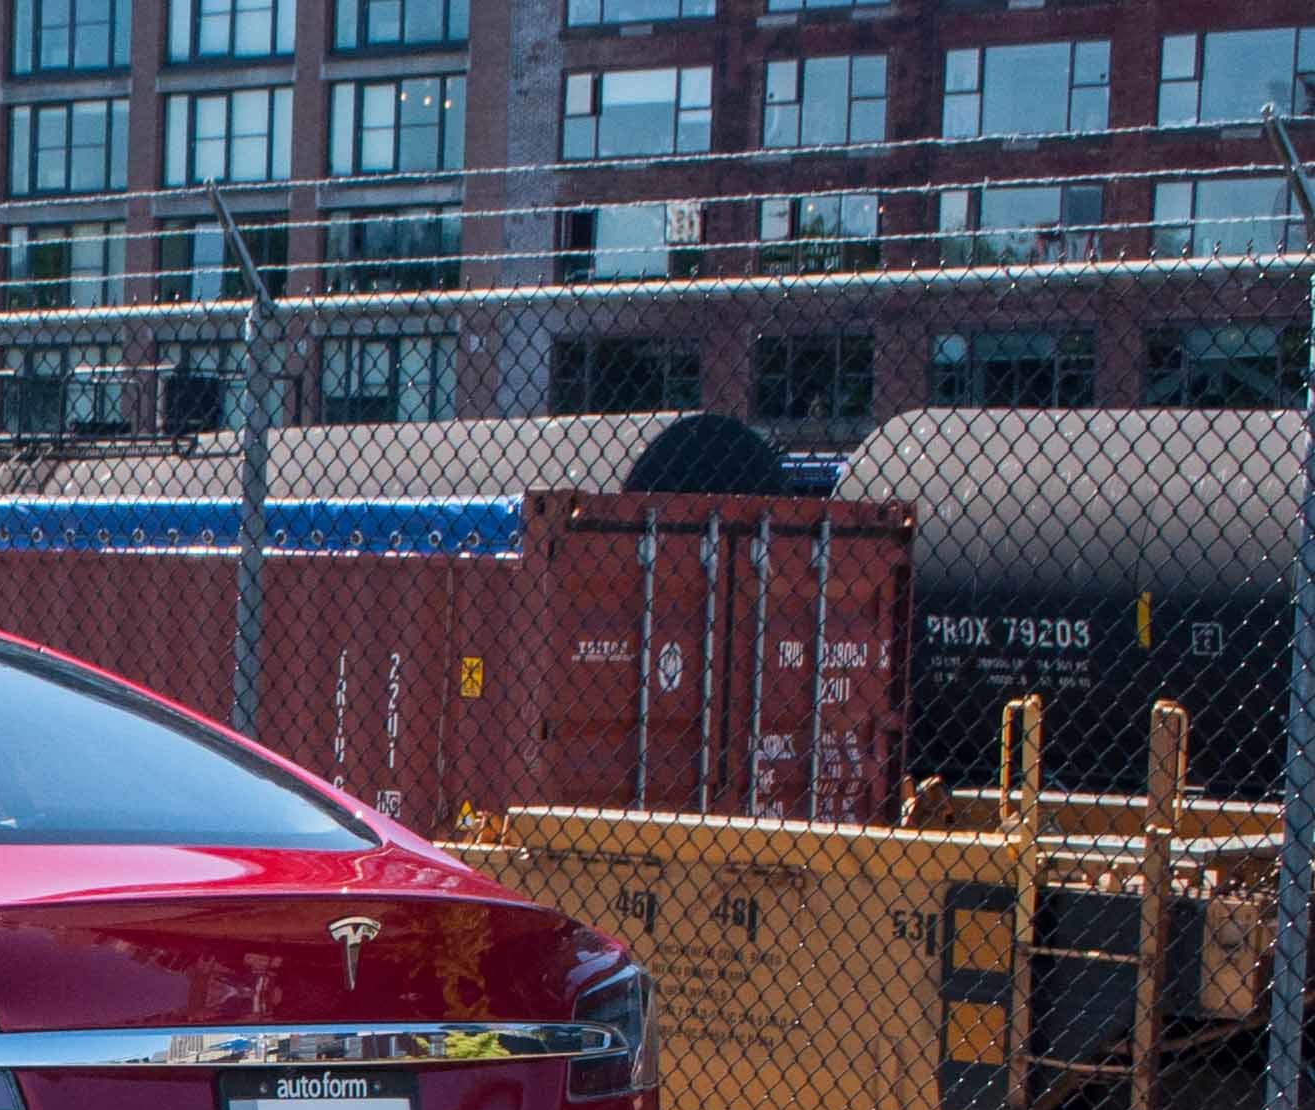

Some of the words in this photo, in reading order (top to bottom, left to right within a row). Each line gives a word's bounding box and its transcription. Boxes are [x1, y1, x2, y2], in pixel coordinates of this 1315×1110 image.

[927, 615, 991, 646] PROX
[1002, 617, 1090, 648] 79203
[277, 1072, 368, 1098] autoform
